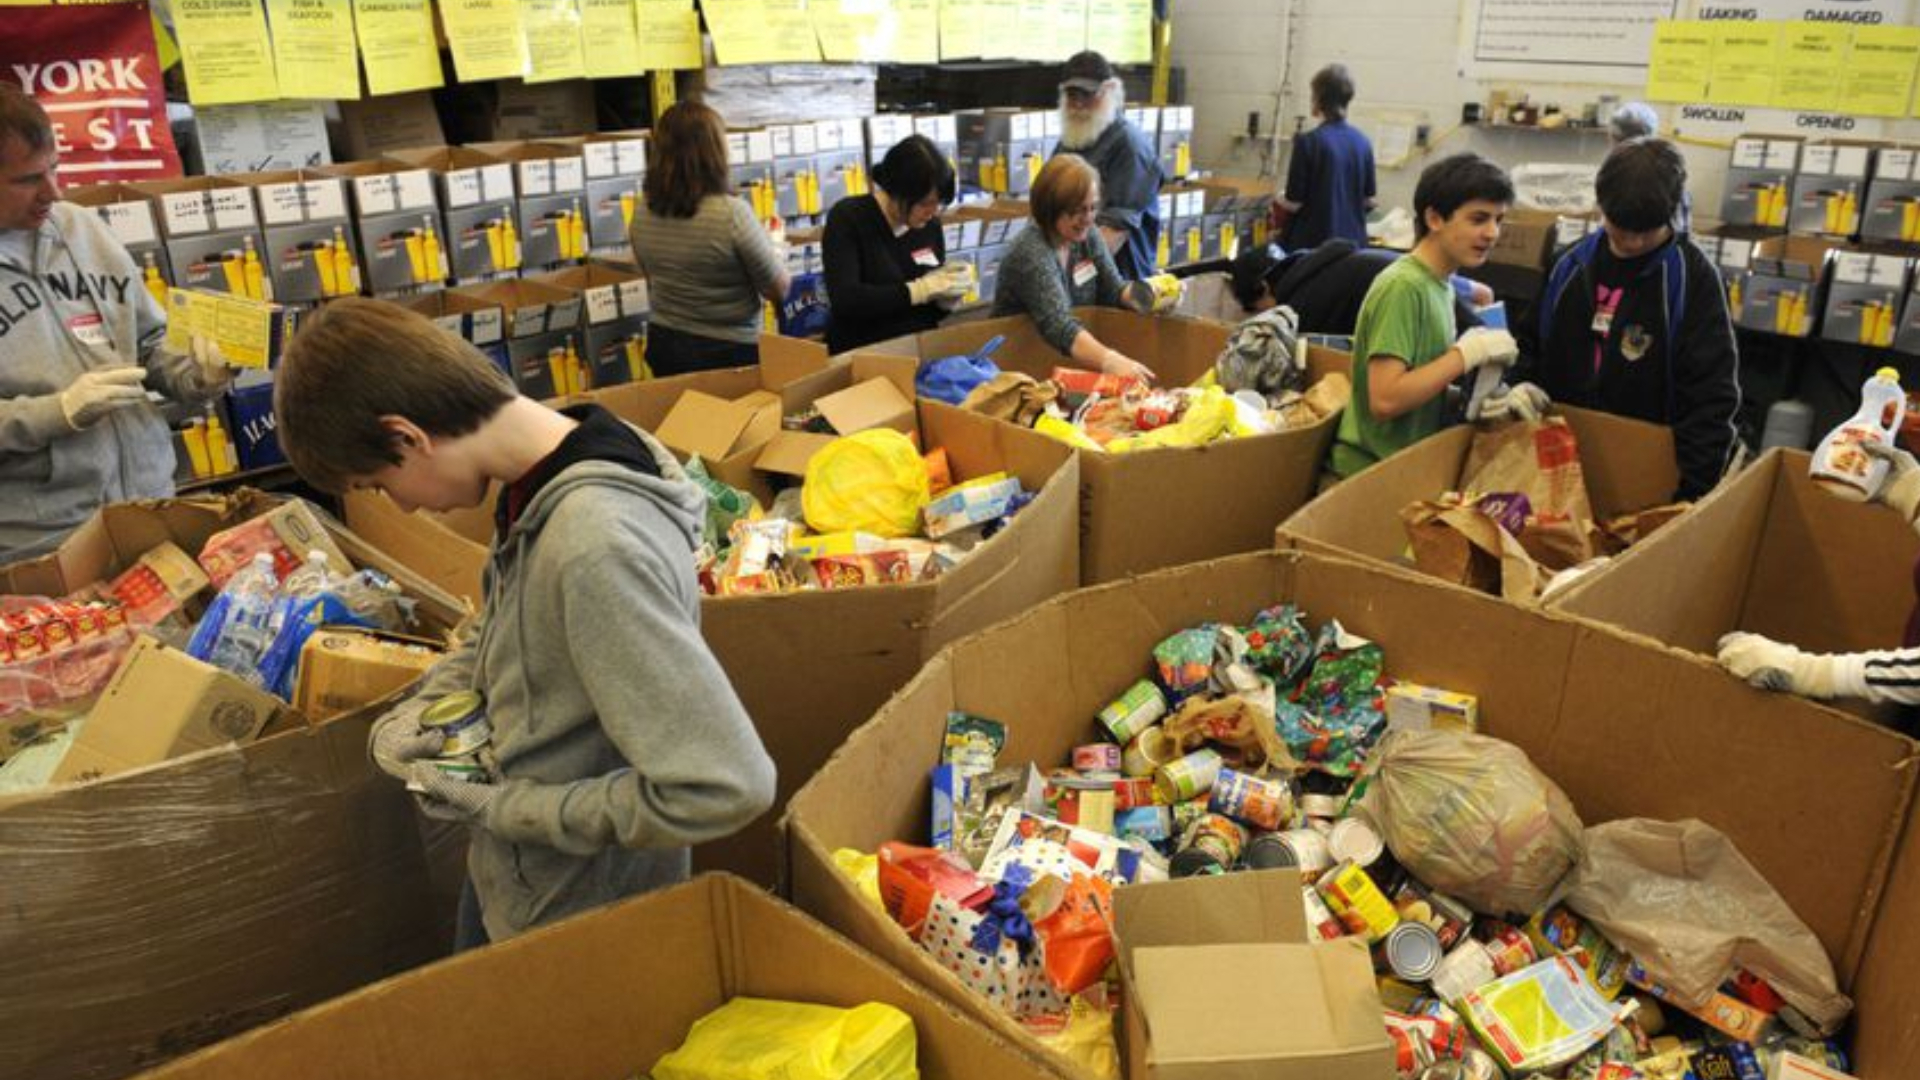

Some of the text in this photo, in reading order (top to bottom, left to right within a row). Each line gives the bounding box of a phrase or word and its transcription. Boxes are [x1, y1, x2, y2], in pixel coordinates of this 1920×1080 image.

[1699, 8, 1758, 22] LEAKING
[1803, 9, 1883, 25] DAMAGED
[12, 55, 147, 95] YORK
[1682, 107, 1746, 122] SWOLLEN
[1796, 115, 1855, 130] OPENED
[51, 117, 155, 153] EST
[47, 269, 130, 304] NAVY
